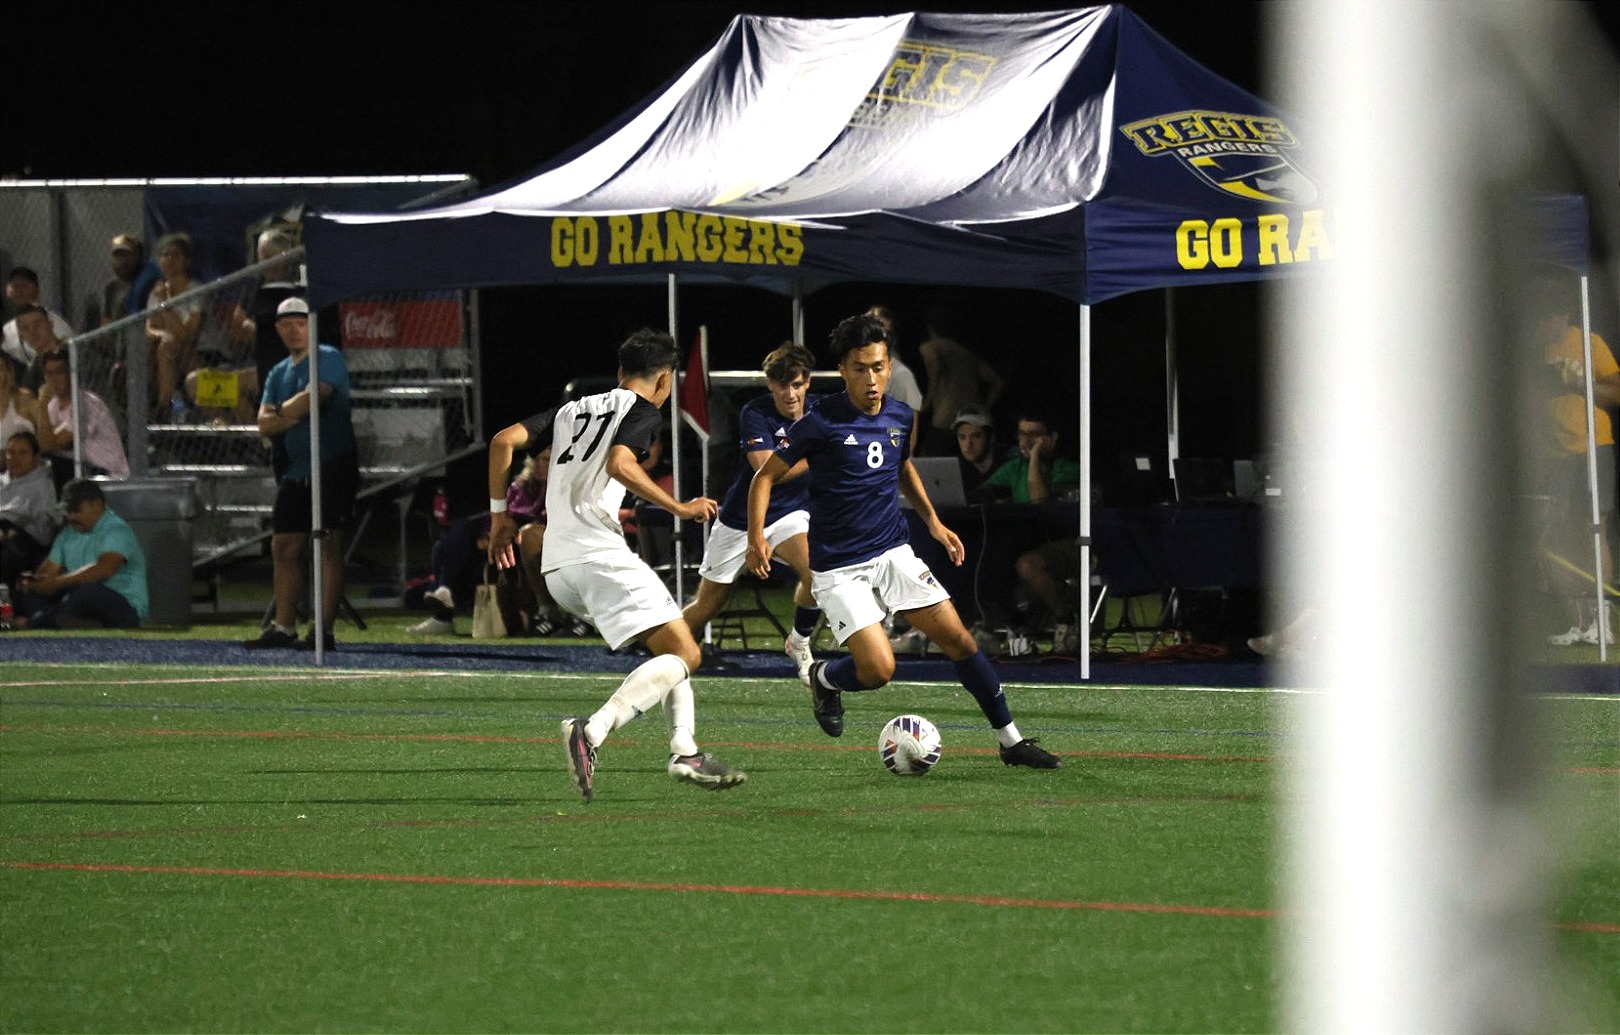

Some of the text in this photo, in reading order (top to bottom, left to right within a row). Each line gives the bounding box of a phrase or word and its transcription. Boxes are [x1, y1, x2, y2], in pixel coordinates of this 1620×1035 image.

[1130, 111, 1290, 150] REGIS
[1177, 141, 1276, 158] RANGERS
[551, 210, 805, 267] GO RANGERS
[1175, 208, 1338, 270] GO RA
[556, 410, 616, 465] 27
[866, 441, 884, 469] 8
